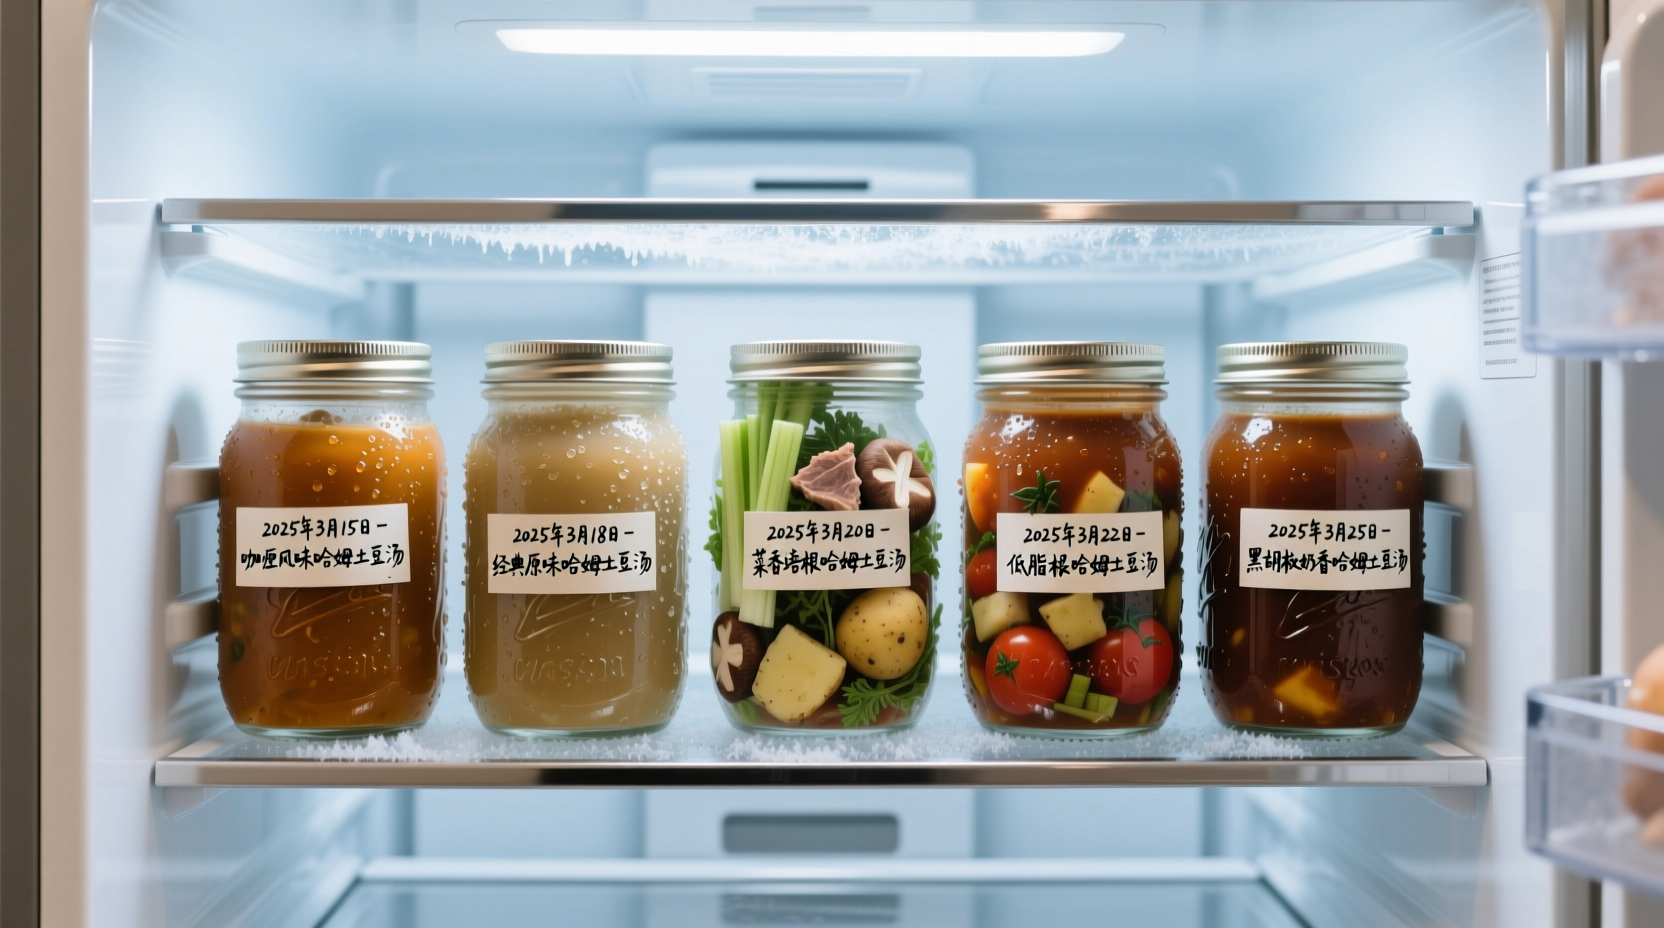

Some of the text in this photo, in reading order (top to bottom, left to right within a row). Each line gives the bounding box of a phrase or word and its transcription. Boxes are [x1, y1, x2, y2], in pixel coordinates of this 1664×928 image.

[492, 551, 652, 578] 经典原味哈姆土豆汤
